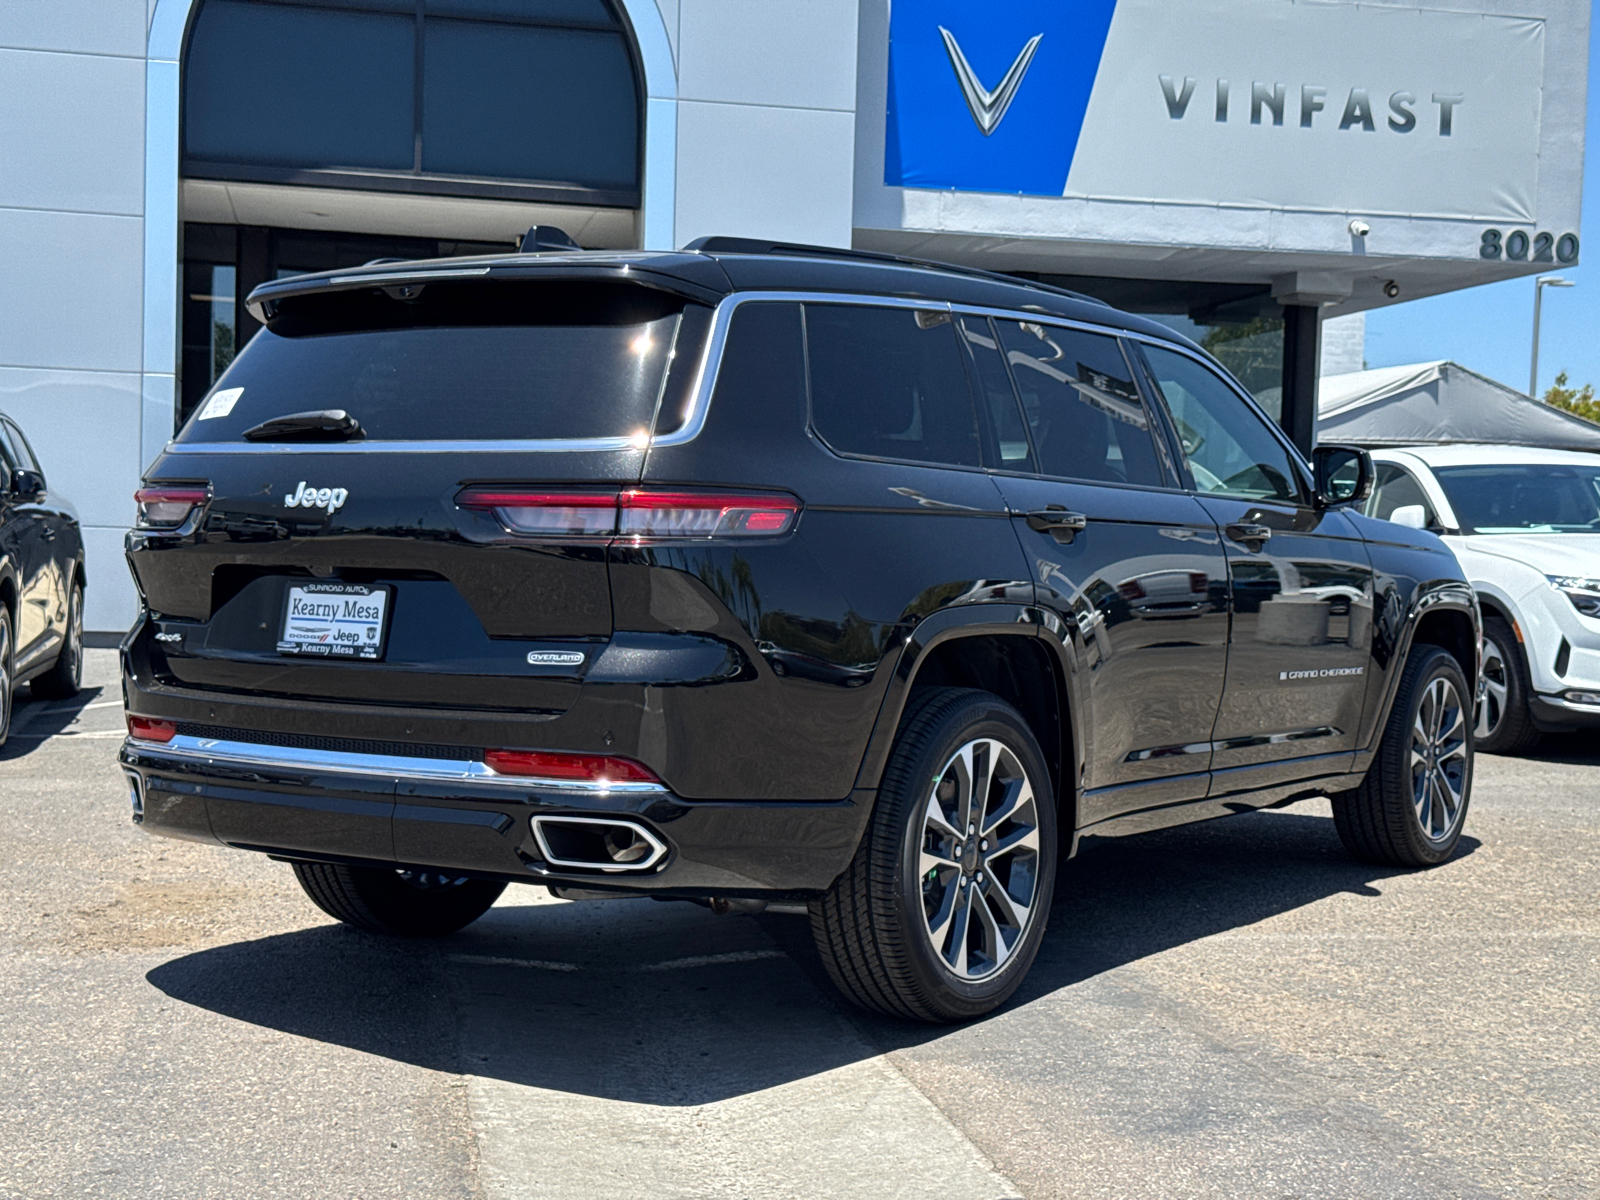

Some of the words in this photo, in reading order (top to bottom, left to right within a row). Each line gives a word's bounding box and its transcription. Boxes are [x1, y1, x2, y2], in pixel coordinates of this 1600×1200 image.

[1158, 74, 1464, 137] VINFAST
[1480, 229, 1579, 263] 8020
[285, 481, 348, 514] Jeep
[308, 584, 344, 592] SUNROAD
[345, 585, 365, 593] AUTO
[291, 598, 340, 623] Kearny
[343, 600, 379, 620] Mesa
[333, 628, 360, 644] Jeep
[301, 643, 331, 656] Kearny
[332, 644, 354, 655] Mesa
[1288, 670, 1318, 679] GRAND
[1320, 667, 1363, 677] CHEROKEE
